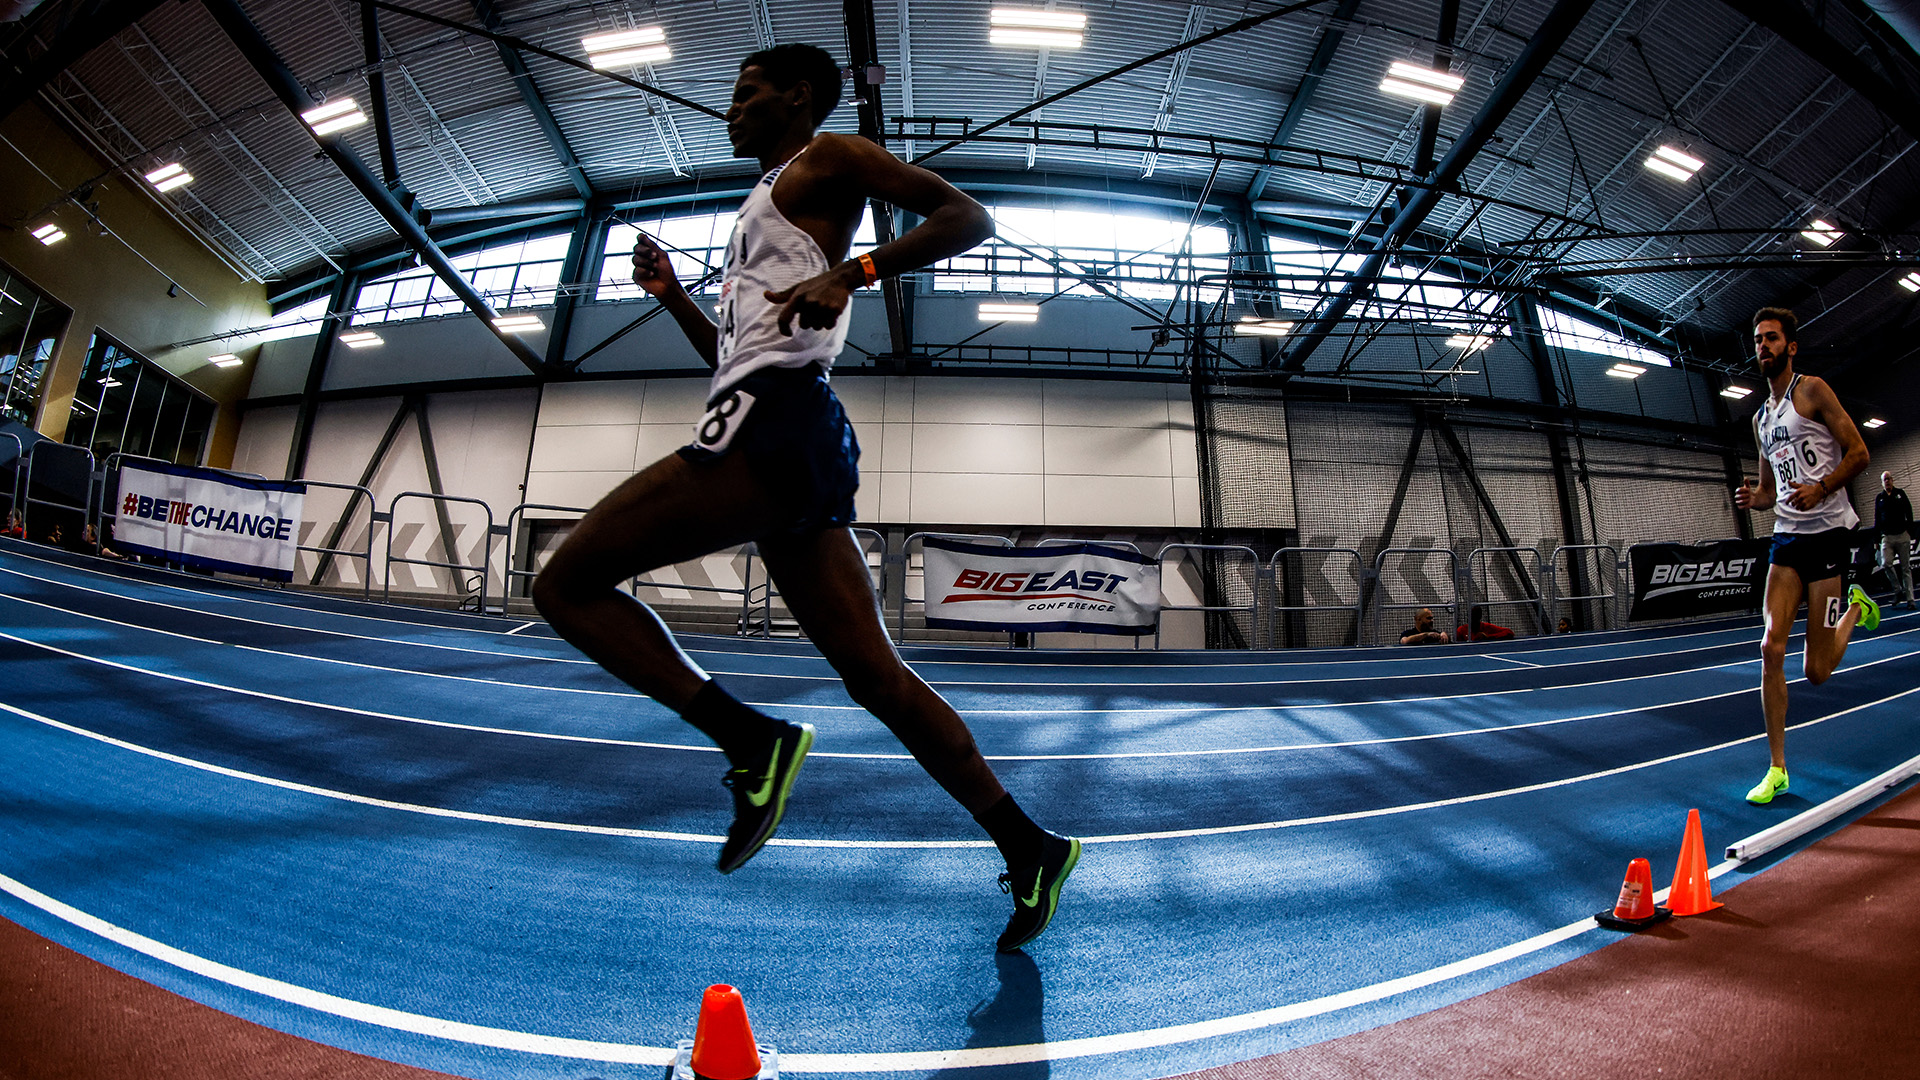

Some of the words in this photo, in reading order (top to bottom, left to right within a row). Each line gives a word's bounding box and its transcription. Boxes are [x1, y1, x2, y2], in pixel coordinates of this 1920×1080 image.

[699, 393, 742, 446] 8
[1801, 440, 1817, 467] 6
[1777, 457, 1797, 483] 687
[1697, 586, 1752, 599] CONFERENCE
[1027, 601, 1117, 613] CONFERENCE
[1827, 598, 1838, 627] 6
